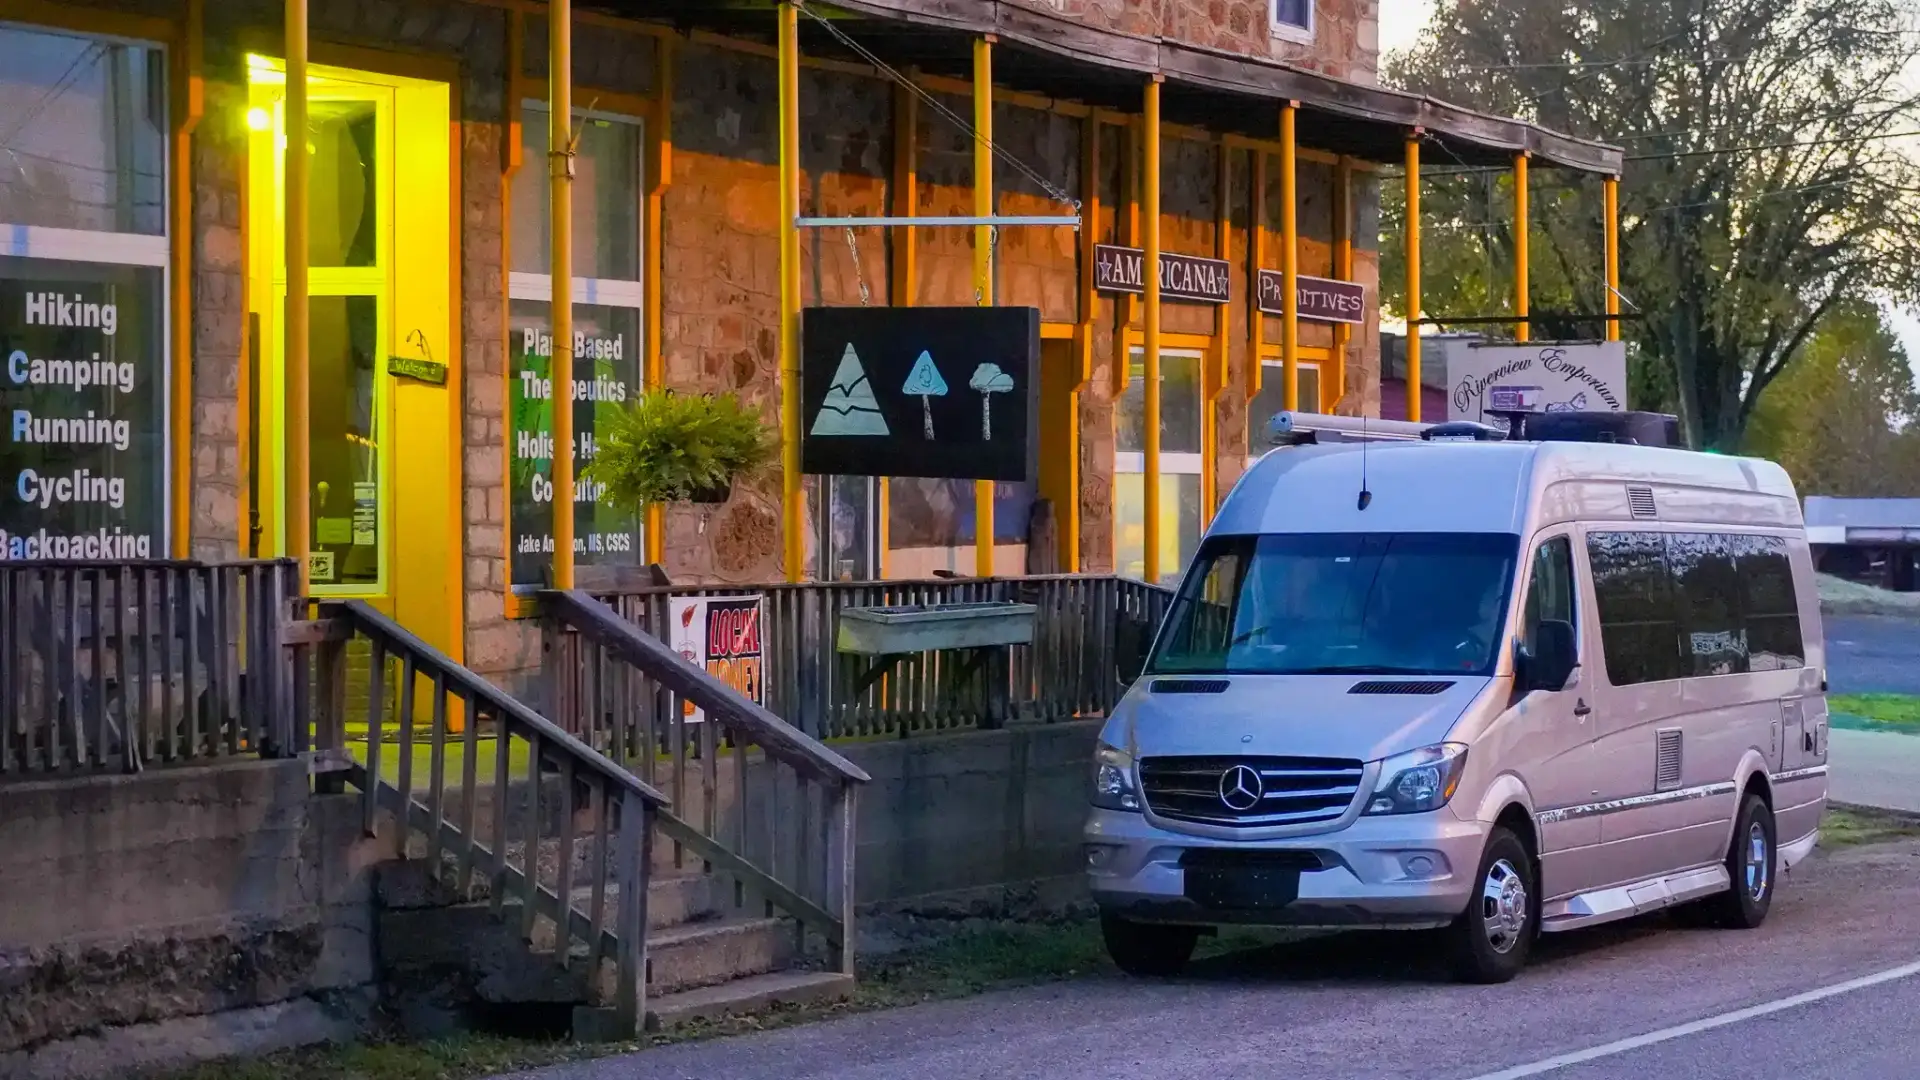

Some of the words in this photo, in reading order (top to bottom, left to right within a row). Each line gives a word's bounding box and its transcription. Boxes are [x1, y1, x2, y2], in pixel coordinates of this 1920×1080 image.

[1112, 253, 1218, 295] AMRICANA
[1262, 275, 1361, 311] PRITIVES
[26, 291, 118, 336] Hiking
[574, 330, 623, 361] Based
[8, 350, 135, 393] Camping
[521, 371, 626, 402] Theeutics
[1453, 356, 1533, 413] Riverview
[1539, 348, 1622, 411] Emporium
[13, 409, 130, 451] Running
[18, 468, 125, 510] Cycling
[518, 534, 541, 553] Jake
[543, 534, 587, 555] Anon,
[606, 532, 630, 552] CSCS
[710, 608, 759, 656] LOCAL
